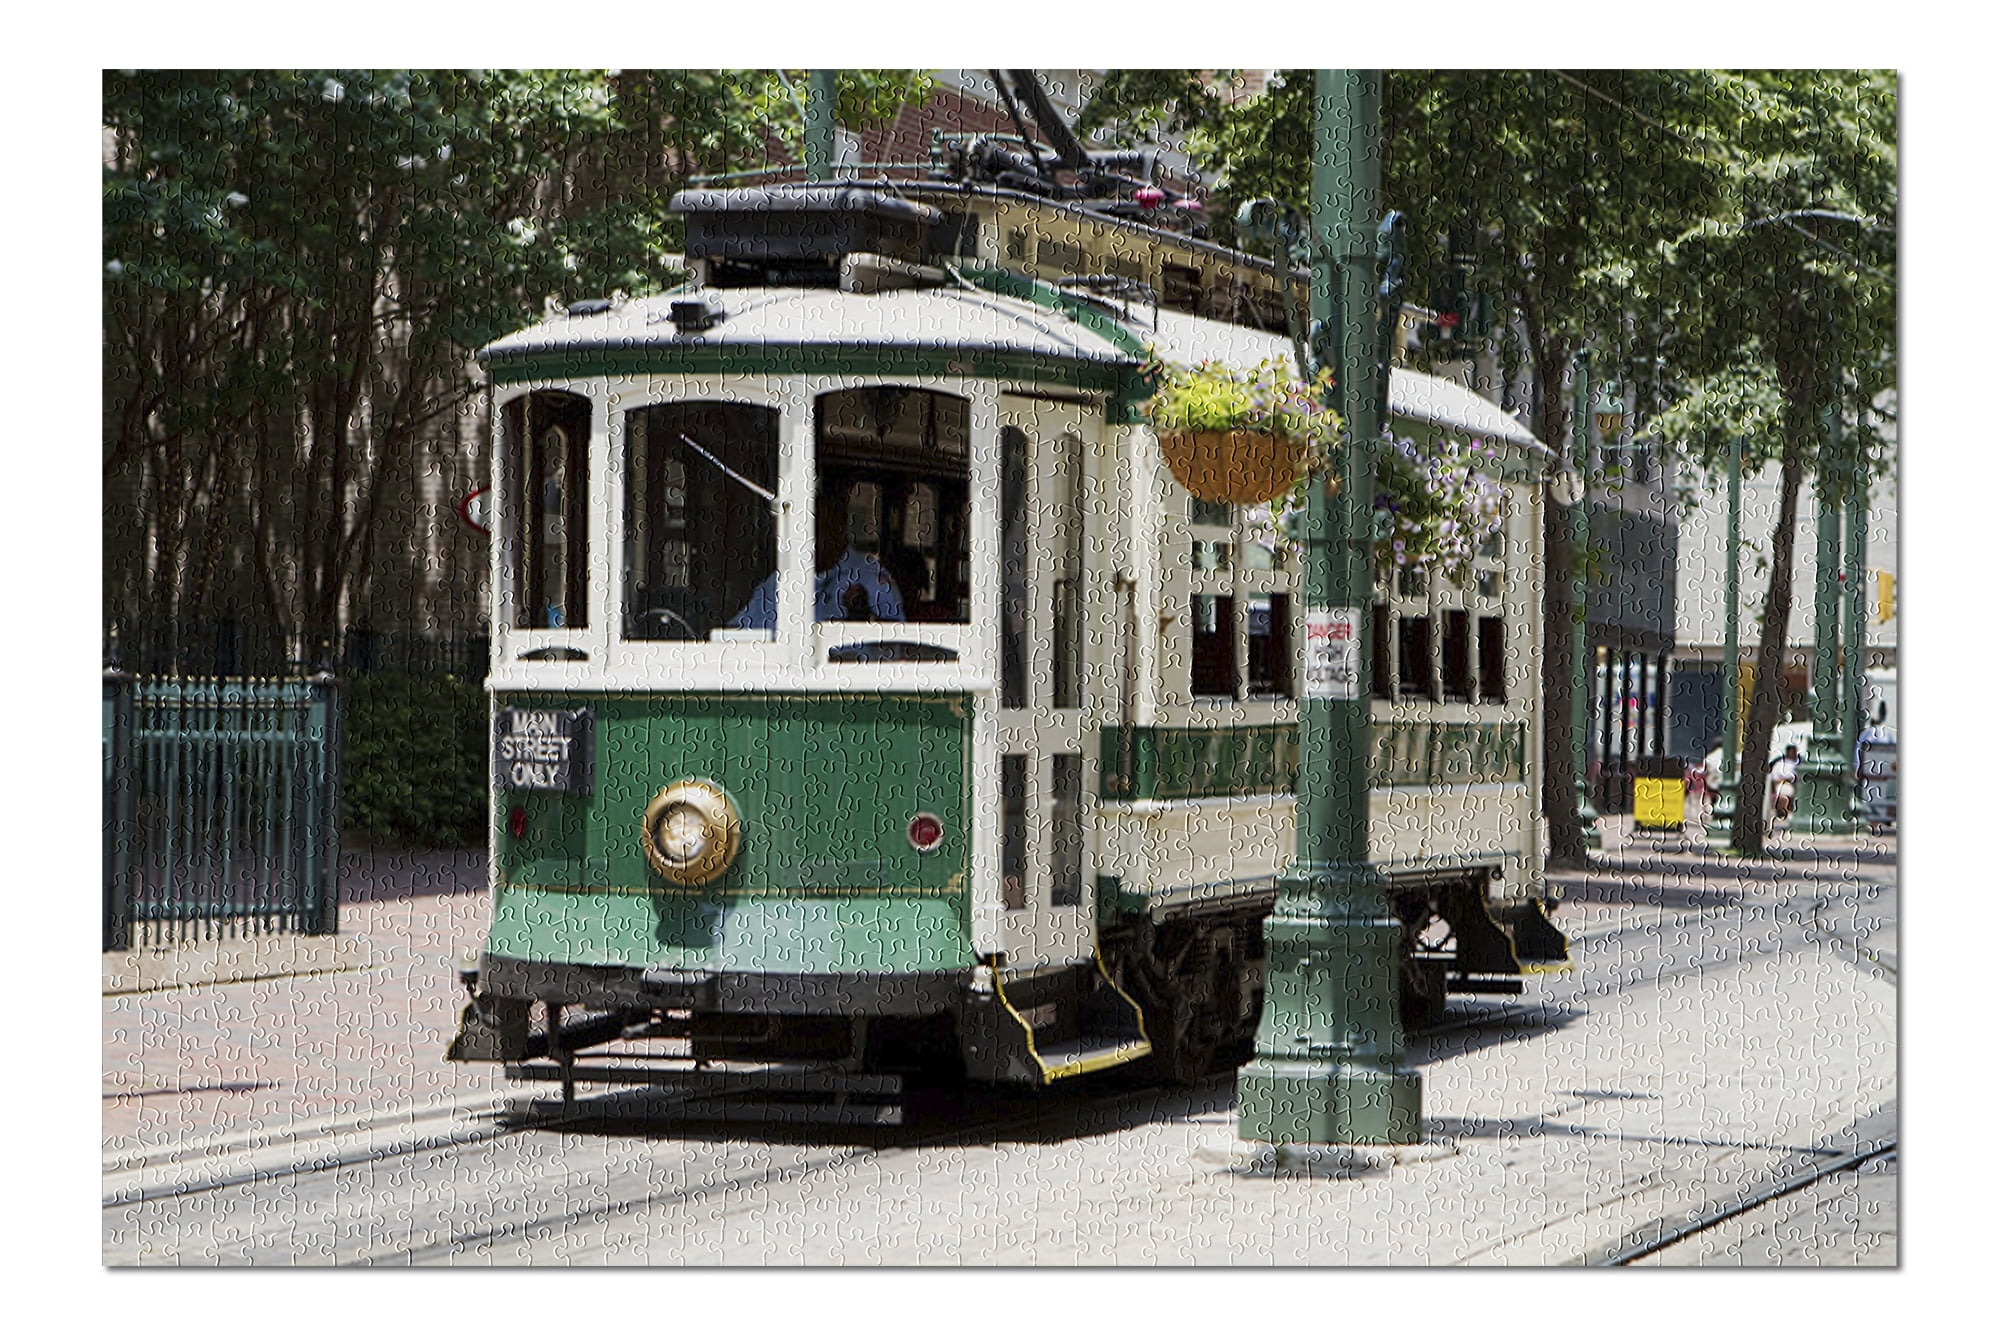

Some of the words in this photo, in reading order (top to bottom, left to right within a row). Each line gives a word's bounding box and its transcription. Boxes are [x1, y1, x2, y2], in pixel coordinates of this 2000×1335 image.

[512, 711, 558, 735] MAIN
[501, 736, 572, 760] STREET
[511, 762, 560, 787] ONLY
